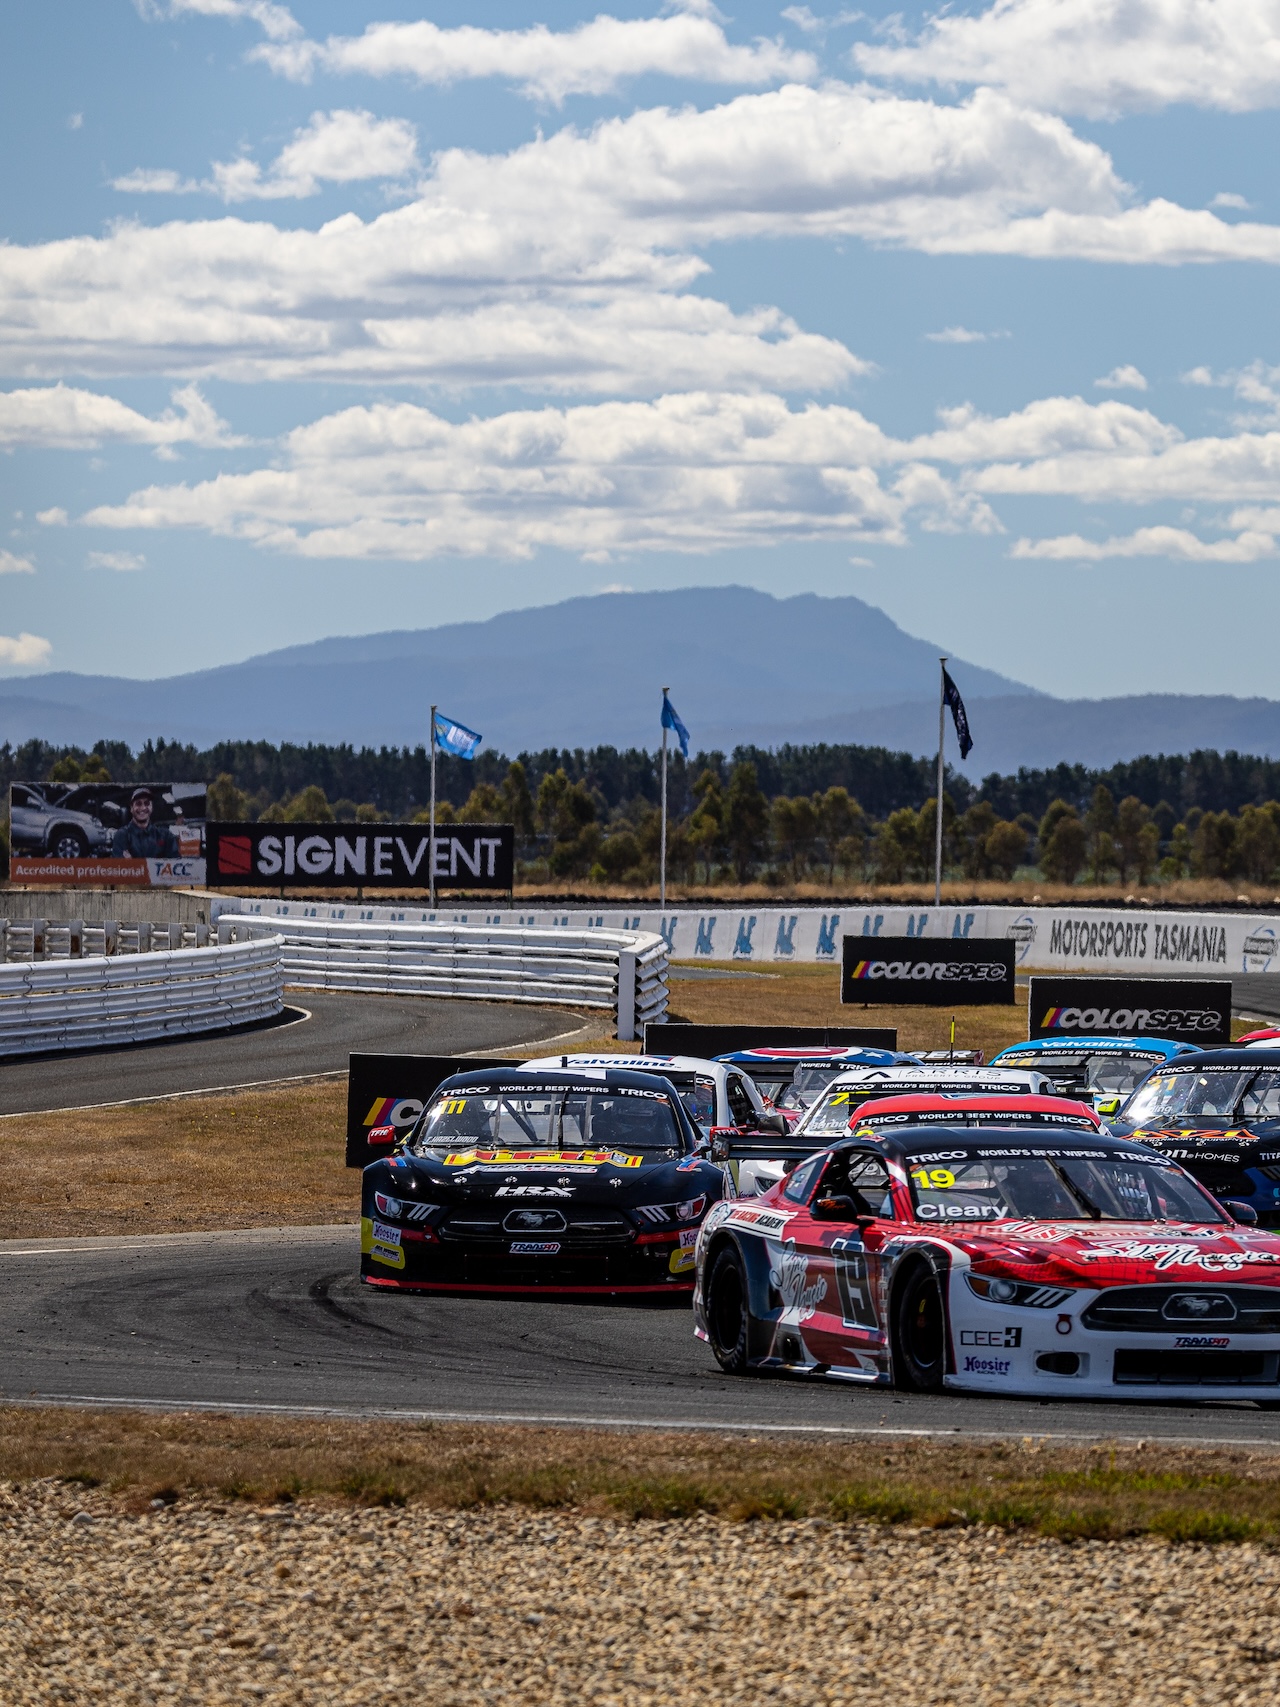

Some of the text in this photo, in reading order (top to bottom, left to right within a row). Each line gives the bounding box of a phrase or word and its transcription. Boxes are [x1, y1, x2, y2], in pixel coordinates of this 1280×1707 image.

[16, 865, 145, 878] Accredited professional
[155, 862, 193, 876] TACC
[1050, 918, 1149, 958] MOTORSPORTS
[1154, 924, 1227, 963] TASMANIA
[868, 960, 1007, 982] COLORSPEC
[1059, 1007, 1222, 1031] COLORSPEC
[1002, 1052, 1036, 1060] TRICO
[1129, 1052, 1166, 1060] TRICO
[1156, 1066, 1196, 1076] TRICO
[440, 1086, 490, 1096] TRICO
[618, 1088, 668, 1099] TRICO
[836, 1084, 875, 1092] TRICO
[979, 1084, 1021, 1092] TRICO
[439, 1100, 468, 1114] 111
[858, 1114, 910, 1126] TRICO
[1040, 1114, 1092, 1125] TRICO
[906, 1150, 968, 1164] TRICO
[1062, 1150, 1106, 1158] WIPERS
[1114, 1152, 1171, 1166] TRICO
[1195, 1152, 1240, 1163] HOMES
[911, 1169, 956, 1190] 19
[494, 1186, 577, 1197] HRX
[916, 1204, 1008, 1219] Cleary
[1175, 1338, 1230, 1348] TRANSAM
[964, 1356, 1010, 1372] Hoosier
